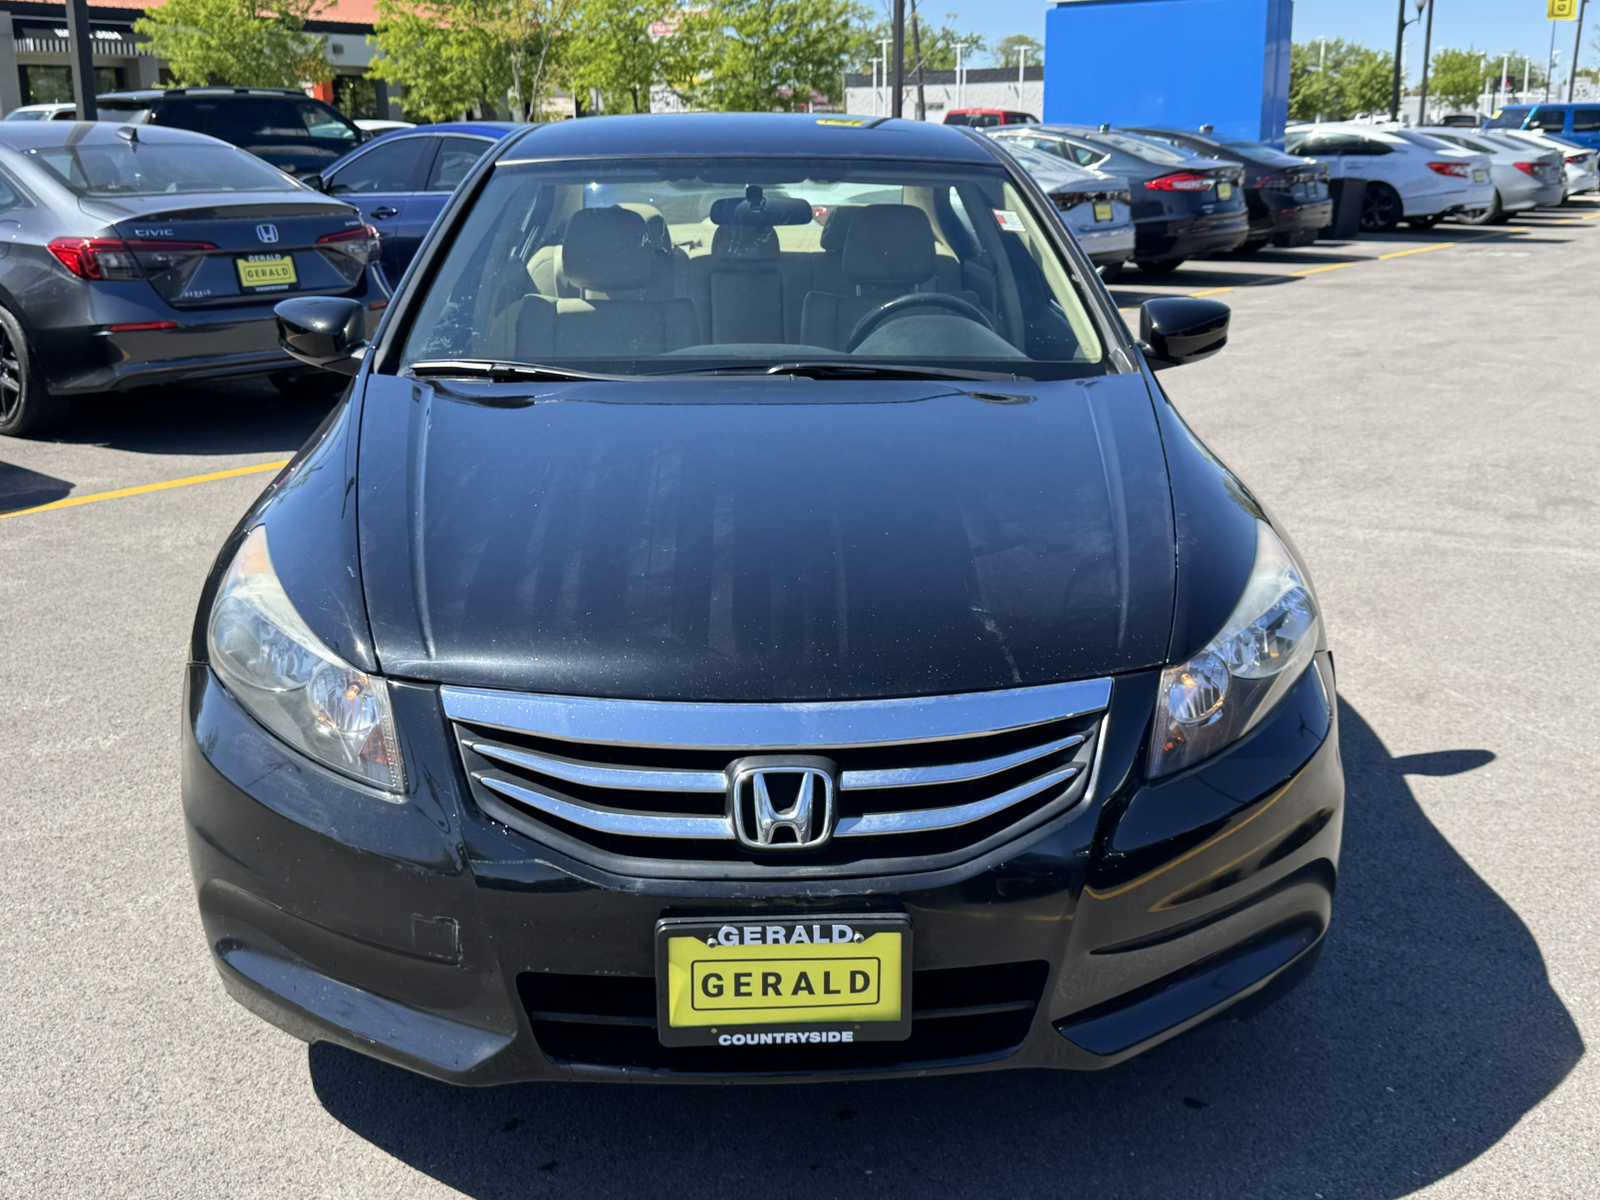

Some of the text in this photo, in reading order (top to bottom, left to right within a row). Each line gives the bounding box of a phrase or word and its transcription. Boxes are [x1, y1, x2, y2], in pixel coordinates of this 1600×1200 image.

[134, 229, 174, 237] CIVIC
[248, 253, 281, 262] GERALD
[247, 267, 288, 278] GERALD
[717, 925, 854, 948] GERALD
[701, 970, 871, 998] GERALD
[718, 1031, 854, 1046] COUNTRYSIDE
